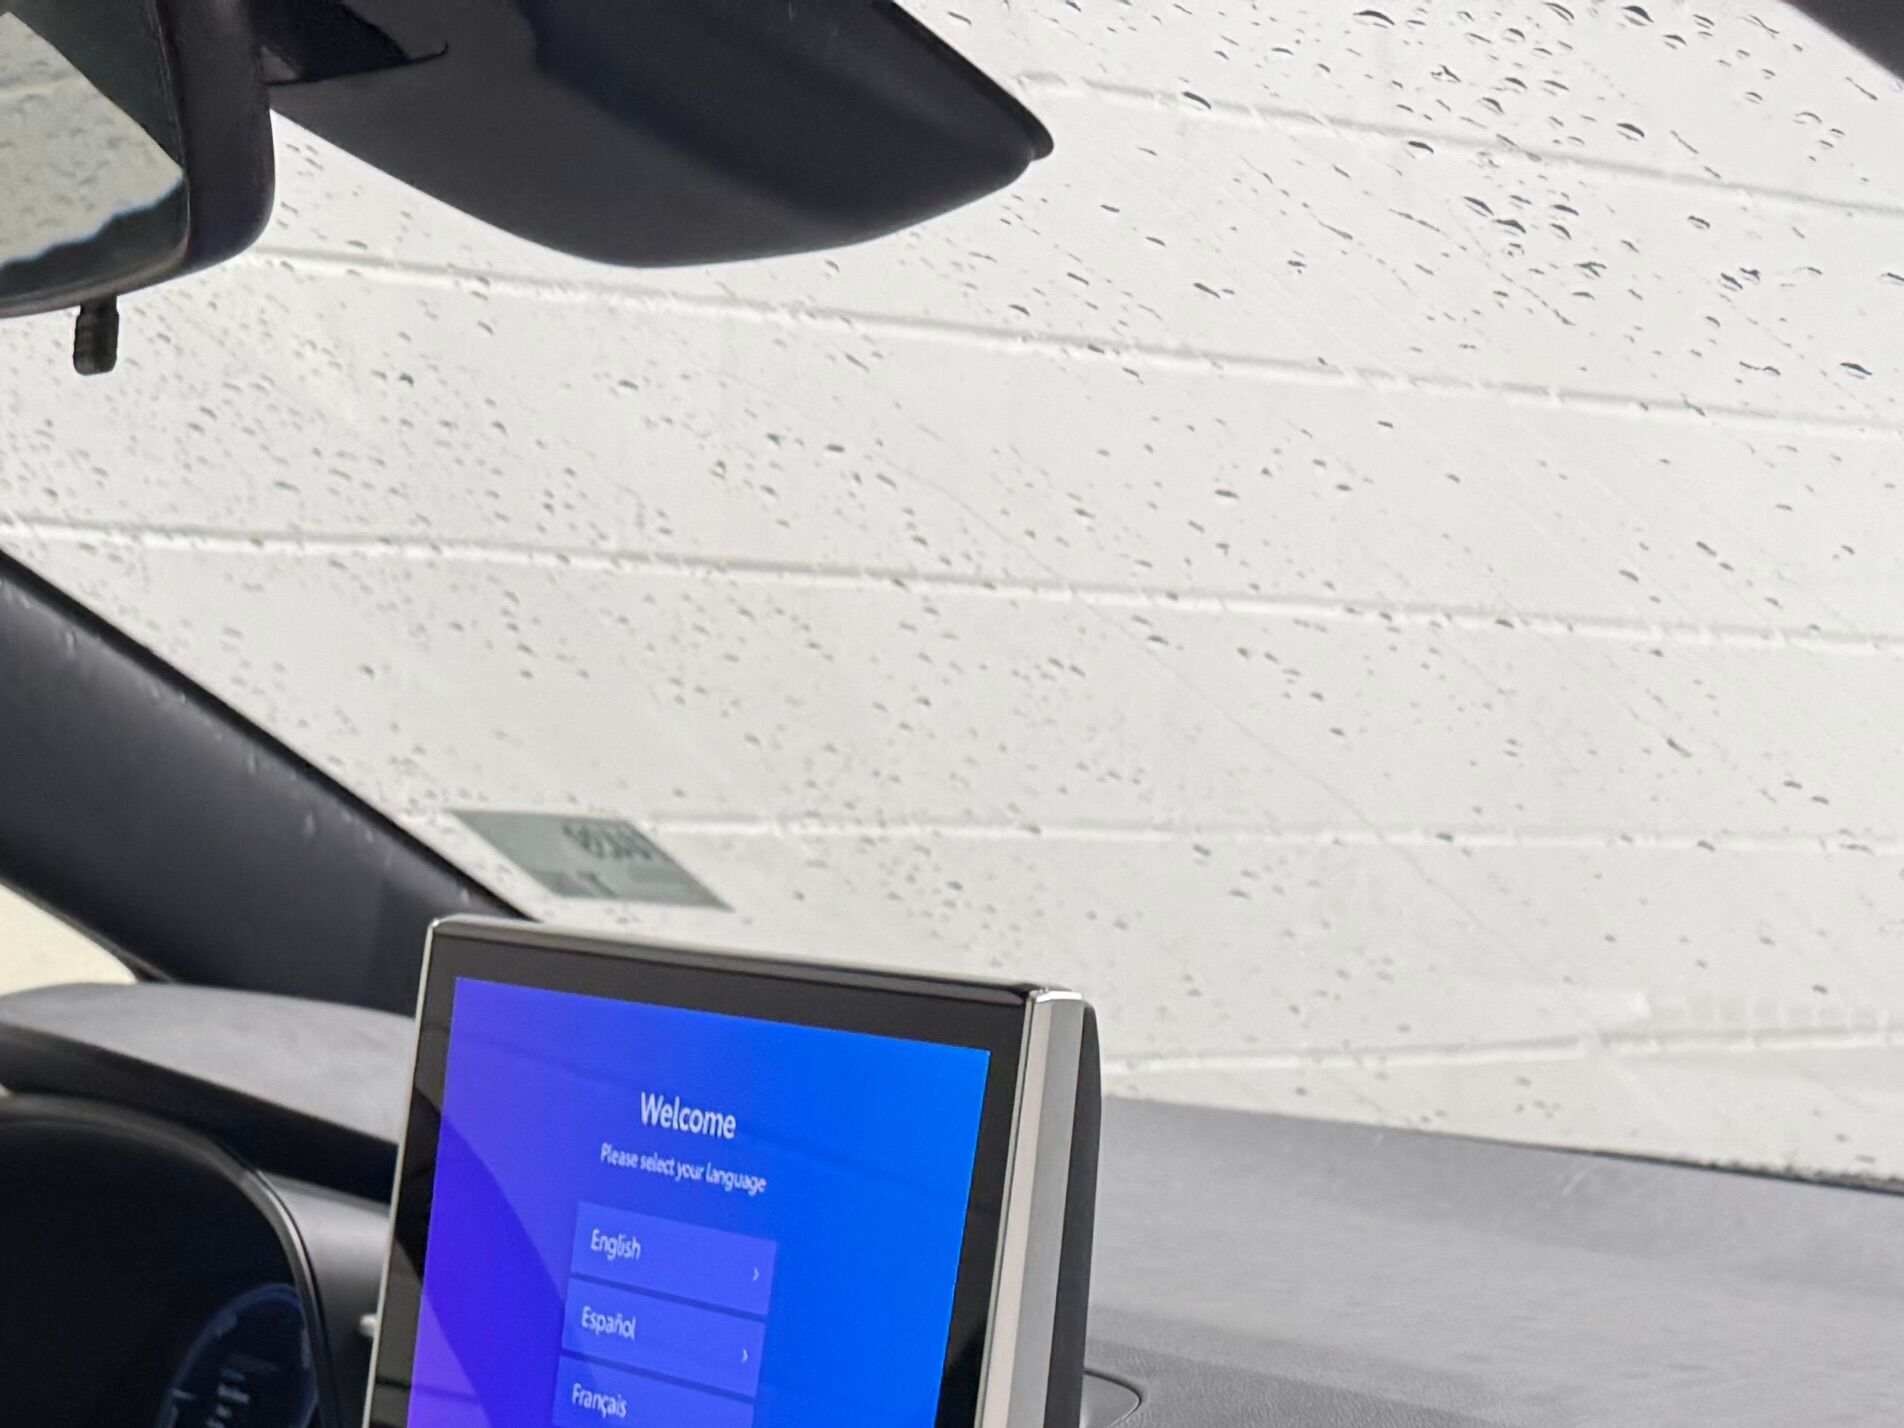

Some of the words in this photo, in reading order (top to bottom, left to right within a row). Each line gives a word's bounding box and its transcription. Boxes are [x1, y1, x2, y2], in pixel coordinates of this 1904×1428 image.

[640, 1091, 737, 1140] Welcome
[600, 1142, 639, 1169] Please
[639, 1151, 676, 1176] select
[674, 1160, 705, 1182] your
[704, 1161, 768, 1197] language
[590, 1228, 642, 1261] English
[581, 1305, 637, 1340] Español
[572, 1382, 627, 1418] Français
